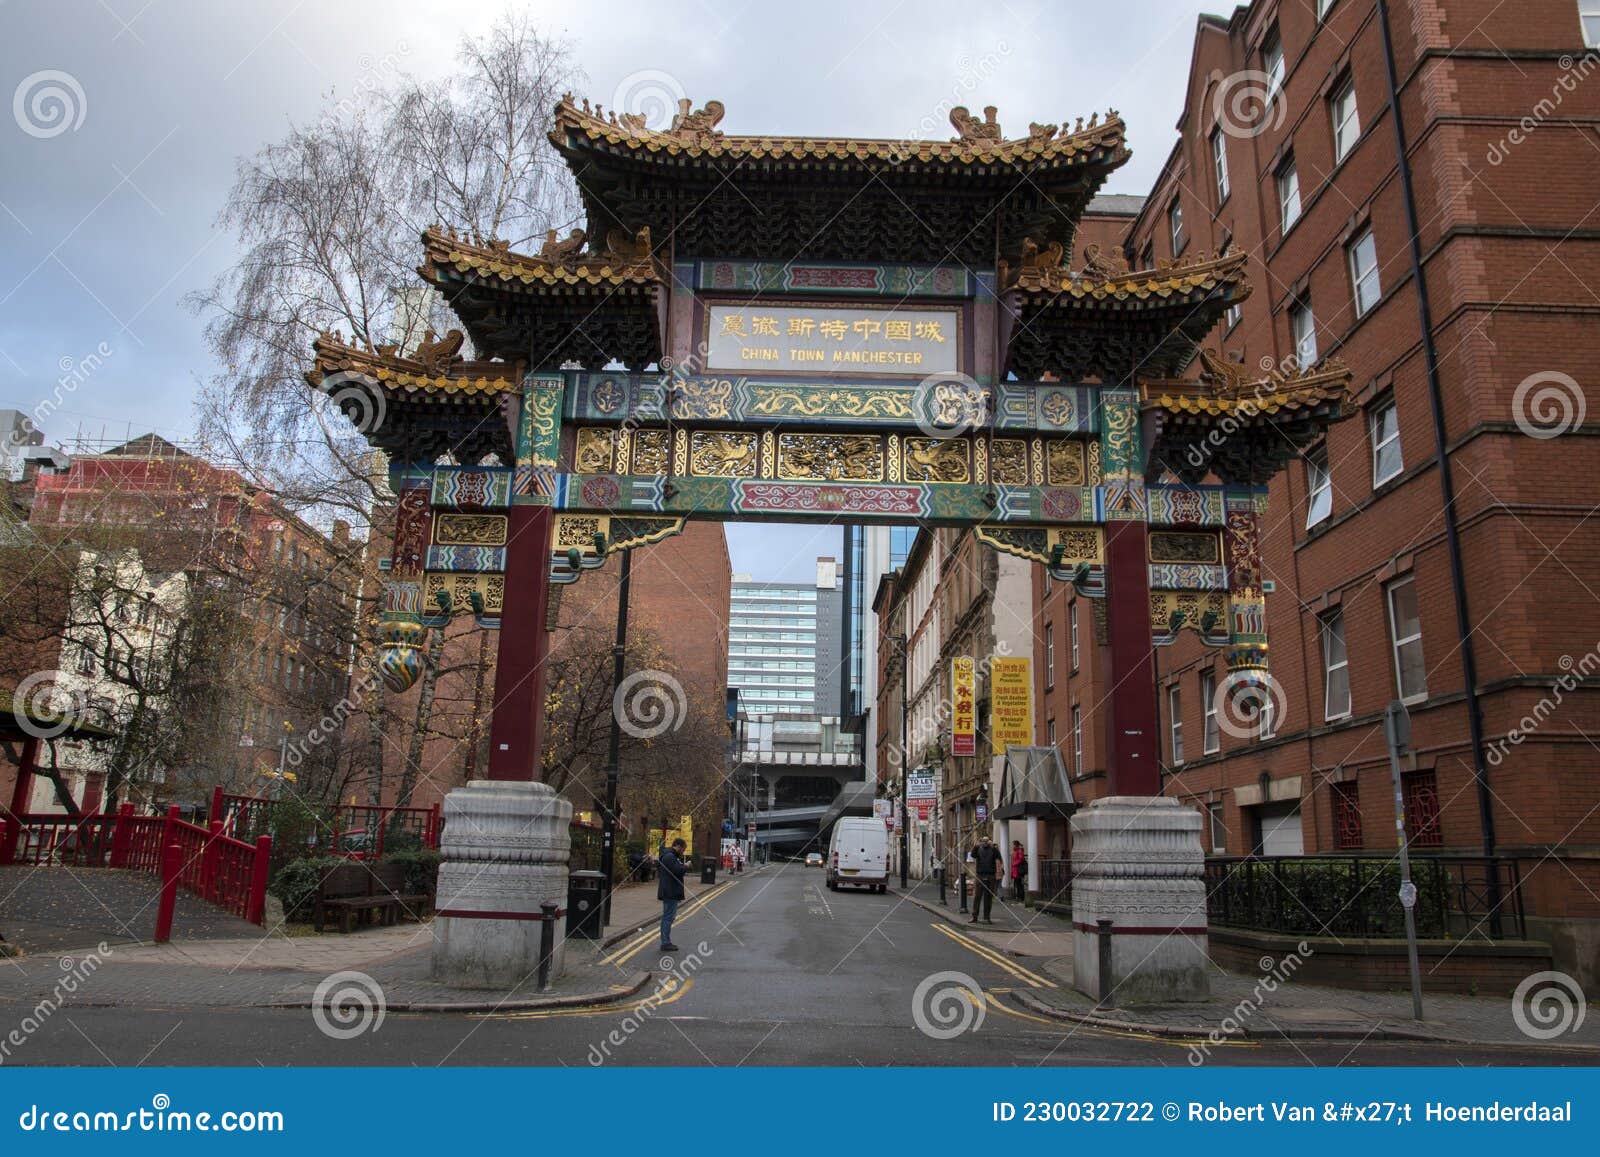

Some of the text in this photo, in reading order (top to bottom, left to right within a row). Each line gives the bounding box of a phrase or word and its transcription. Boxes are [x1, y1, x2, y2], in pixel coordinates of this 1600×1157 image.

[741, 348, 923, 364] CHINA TOWN MANCHESTER
